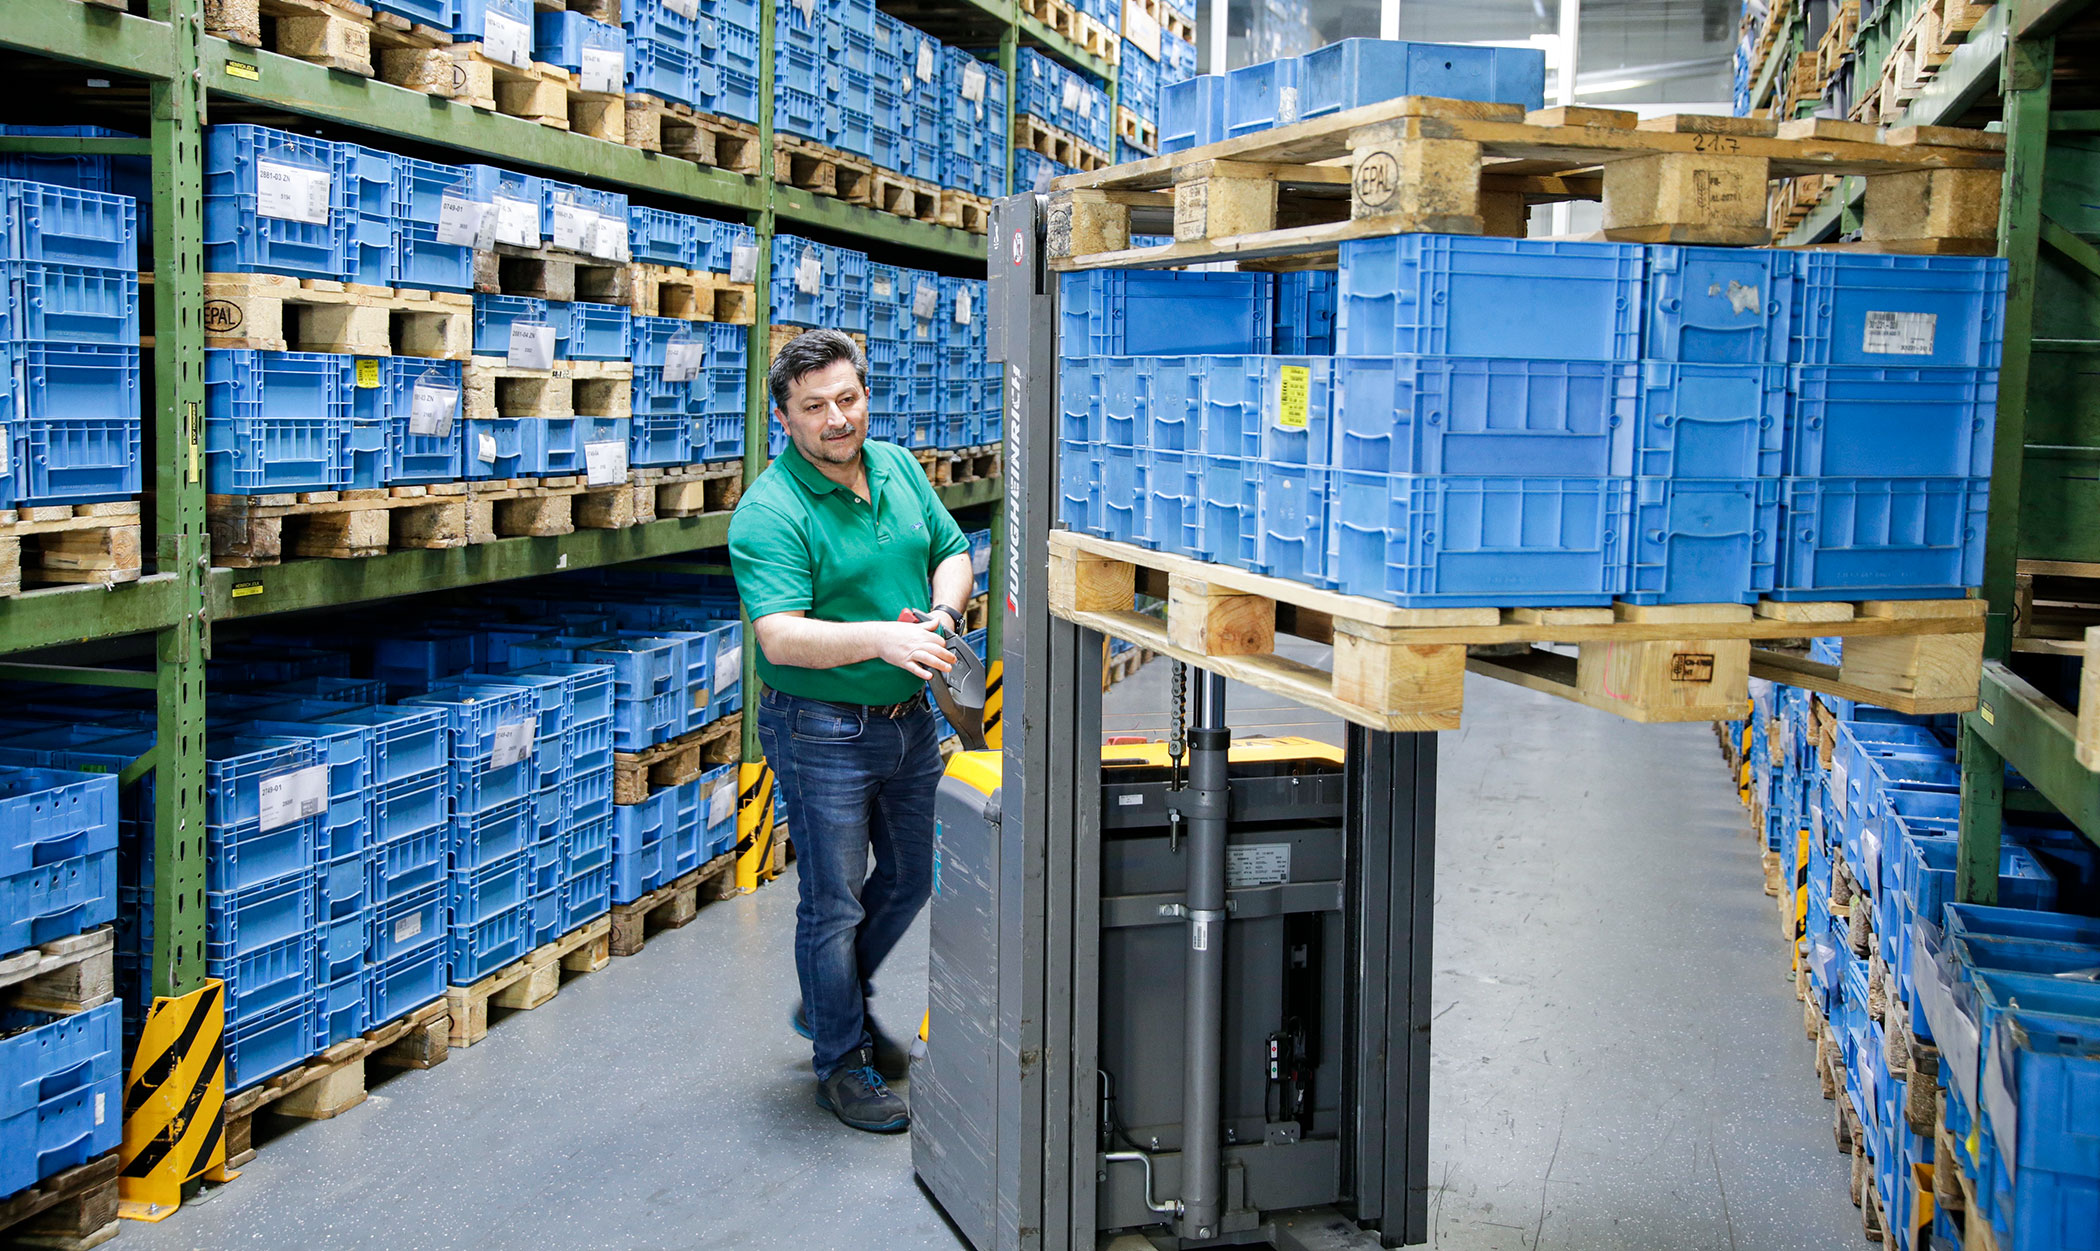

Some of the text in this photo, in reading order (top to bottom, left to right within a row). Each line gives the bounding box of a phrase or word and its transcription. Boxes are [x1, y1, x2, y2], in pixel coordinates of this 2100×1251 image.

[1363, 163, 1392, 195] EPAL
[204, 306, 235, 325] EPAL
[1006, 364, 1021, 618] JUNGHEINRICH
